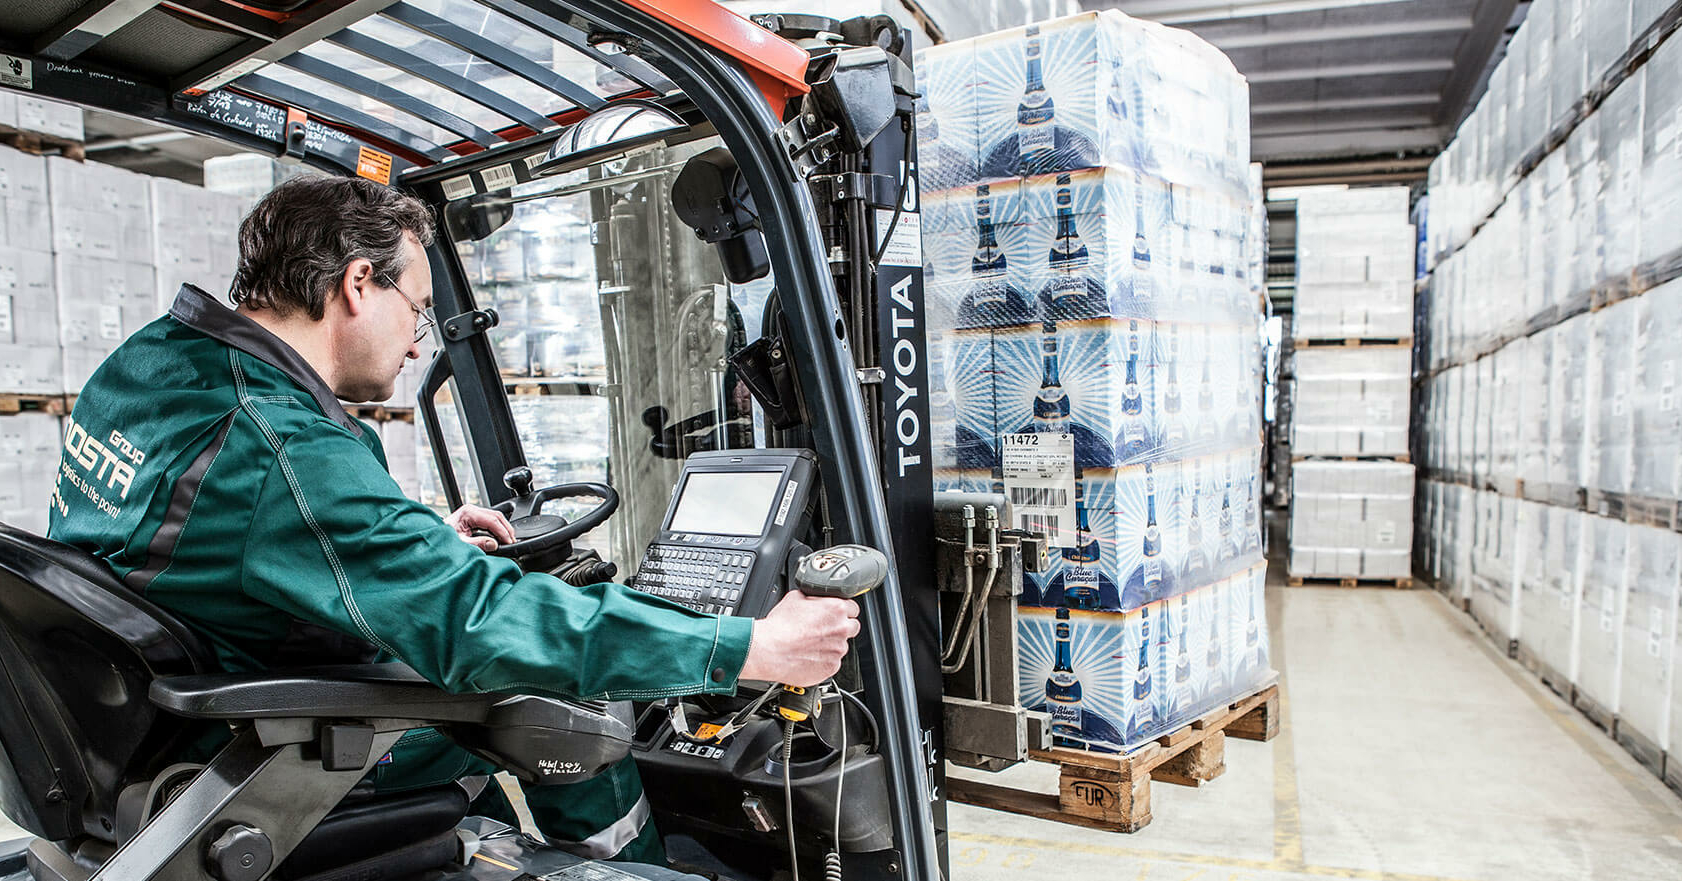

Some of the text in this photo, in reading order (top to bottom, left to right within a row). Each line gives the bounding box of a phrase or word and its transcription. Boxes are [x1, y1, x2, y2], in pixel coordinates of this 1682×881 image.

[890, 273, 921, 478] TOYOTA
[1002, 434, 1039, 446] 11472
[108, 429, 146, 466] Group
[80, 480, 89, 494] to
[87, 486, 100, 504] the
[97, 497, 121, 519] point
[1074, 566, 1093, 576] Blue
[1065, 572, 1098, 585] Curaçao
[1057, 705, 1075, 716] Blue
